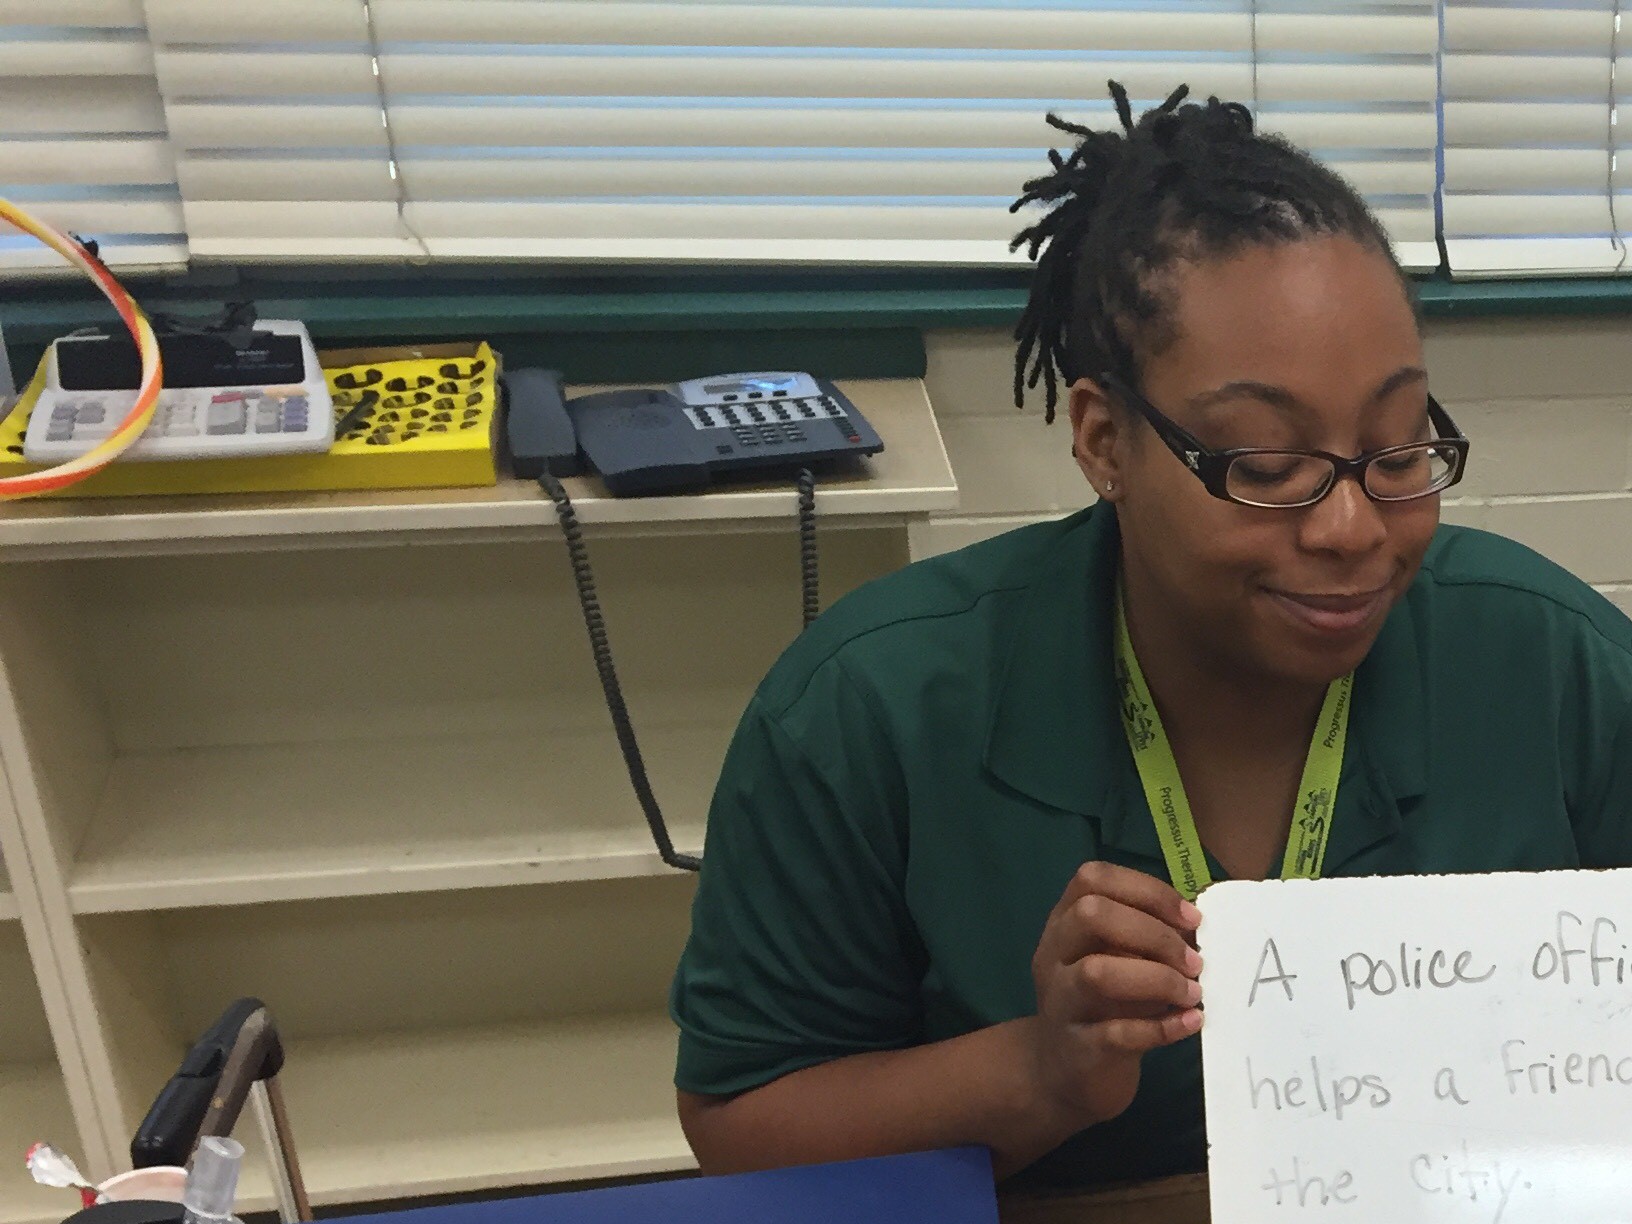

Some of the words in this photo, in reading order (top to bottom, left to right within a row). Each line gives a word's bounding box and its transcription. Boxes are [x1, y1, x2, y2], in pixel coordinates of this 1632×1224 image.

[1323, 690, 1347, 749] Progressus
[1159, 786, 1184, 847] Progressus
[1176, 846, 1200, 894] Therapy
[1247, 937, 1298, 1008] A
[1340, 941, 1497, 1011] police
[1245, 1055, 1393, 1121] helps
[1433, 1068, 1469, 1106] a
[1261, 1154, 1358, 1206] the
